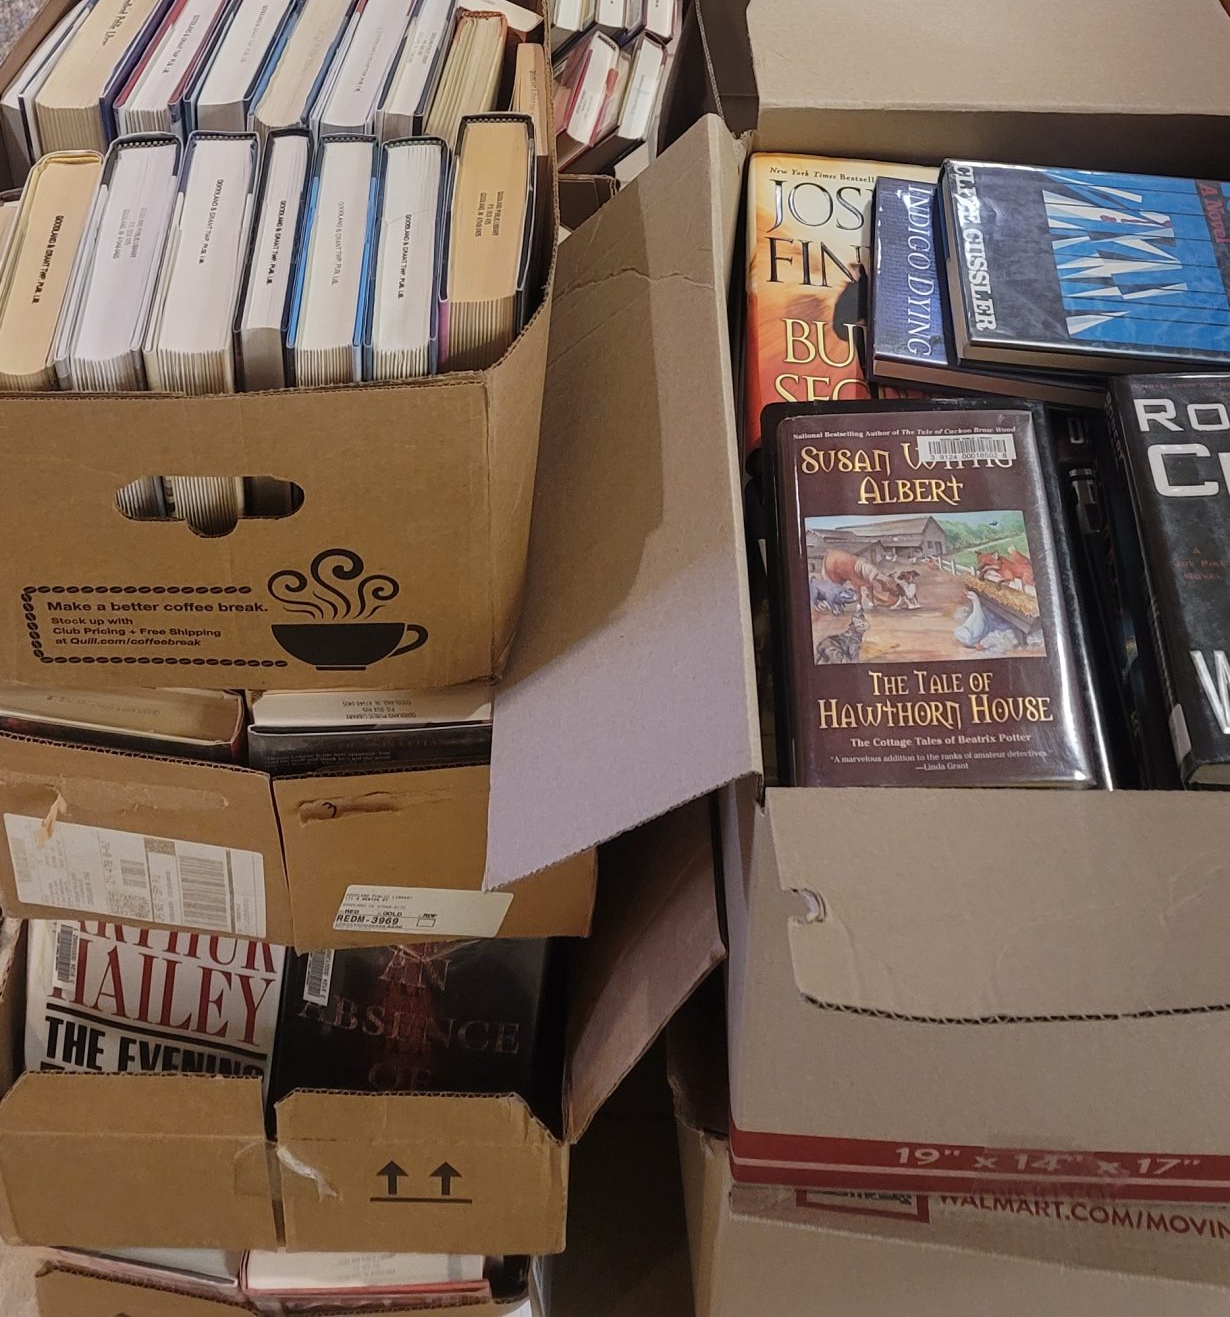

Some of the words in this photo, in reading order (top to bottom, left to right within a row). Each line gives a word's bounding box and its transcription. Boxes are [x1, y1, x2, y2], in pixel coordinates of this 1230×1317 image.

[769, 167, 789, 175] New
[791, 168, 810, 177] York
[813, 171, 837, 180] Times
[1199, 183, 1216, 197] A
[277, 200, 287, 228] GOODLAND
[766, 178, 874, 234] JOS
[403, 213, 412, 242] GOODLAND
[907, 184, 934, 271] INDIGO
[1205, 202, 1230, 244] Novel
[273, 232, 281, 251] GRANT
[41, 249, 54, 268] GRANT
[401, 246, 409, 265] GRANT
[962, 228, 998, 332] CUSSLER
[907, 274, 935, 357] DYING
[792, 431, 824, 441] National
[824, 429, 865, 439] Bestselling
[865, 429, 891, 438] Author
[901, 428, 916, 436] The
[934, 427, 944, 435] of
[943, 427, 973, 435] Cuckoo
[973, 426, 994, 434] Brow
[994, 426, 1017, 434] Wood
[800, 445, 891, 477] SUSAN
[930, 453, 936, 461] 3
[857, 474, 964, 506] ALBERT
[47, 601, 92, 612] Make
[96, 603, 107, 612] a
[110, 601, 160, 612] better
[163, 601, 214, 613] coffee
[217, 602, 269, 613] break.
[50, 617, 87, 625] Stock
[88, 618, 105, 627] up
[107, 617, 134, 626] with
[52, 627, 79, 636] Club
[83, 627, 126, 637] Pricing
[139, 627, 167, 636] Free
[168, 628, 222, 638] Shipping
[55, 637, 68, 645] at
[70, 637, 201, 647] Quill.com/coffeebreak
[868, 669, 910, 697] THE
[913, 668, 964, 695] TALE
[968, 671, 994, 693] OF
[817, 697, 962, 731] HAWTHORN
[967, 693, 1054, 725] HOUSE
[849, 737, 871, 748] The
[872, 736, 913, 749] Cottage
[913, 736, 942, 747] Tales
[944, 735, 957, 746] of
[957, 734, 997, 745] Beatrix
[998, 732, 1033, 744] Potter
[841, 754, 881, 764] marvelous
[882, 753, 916, 763] addition
[916, 753, 926, 762] to
[926, 752, 940, 761] the
[940, 751, 964, 761] ranks
[963, 751, 973, 760] of
[973, 750, 1006, 760] amateur
[946, 761, 969, 771] Grant
[336, 914, 399, 925] REDM-3969
[45, 1015, 106, 1072] THE
[117, 1035, 264, 1079] EVEN
[896, 1147, 961, 1165] 19"
[973, 1154, 996, 1171] x
[1096, 1158, 1122, 1176] x
[1136, 1156, 1201, 1176] 17"
